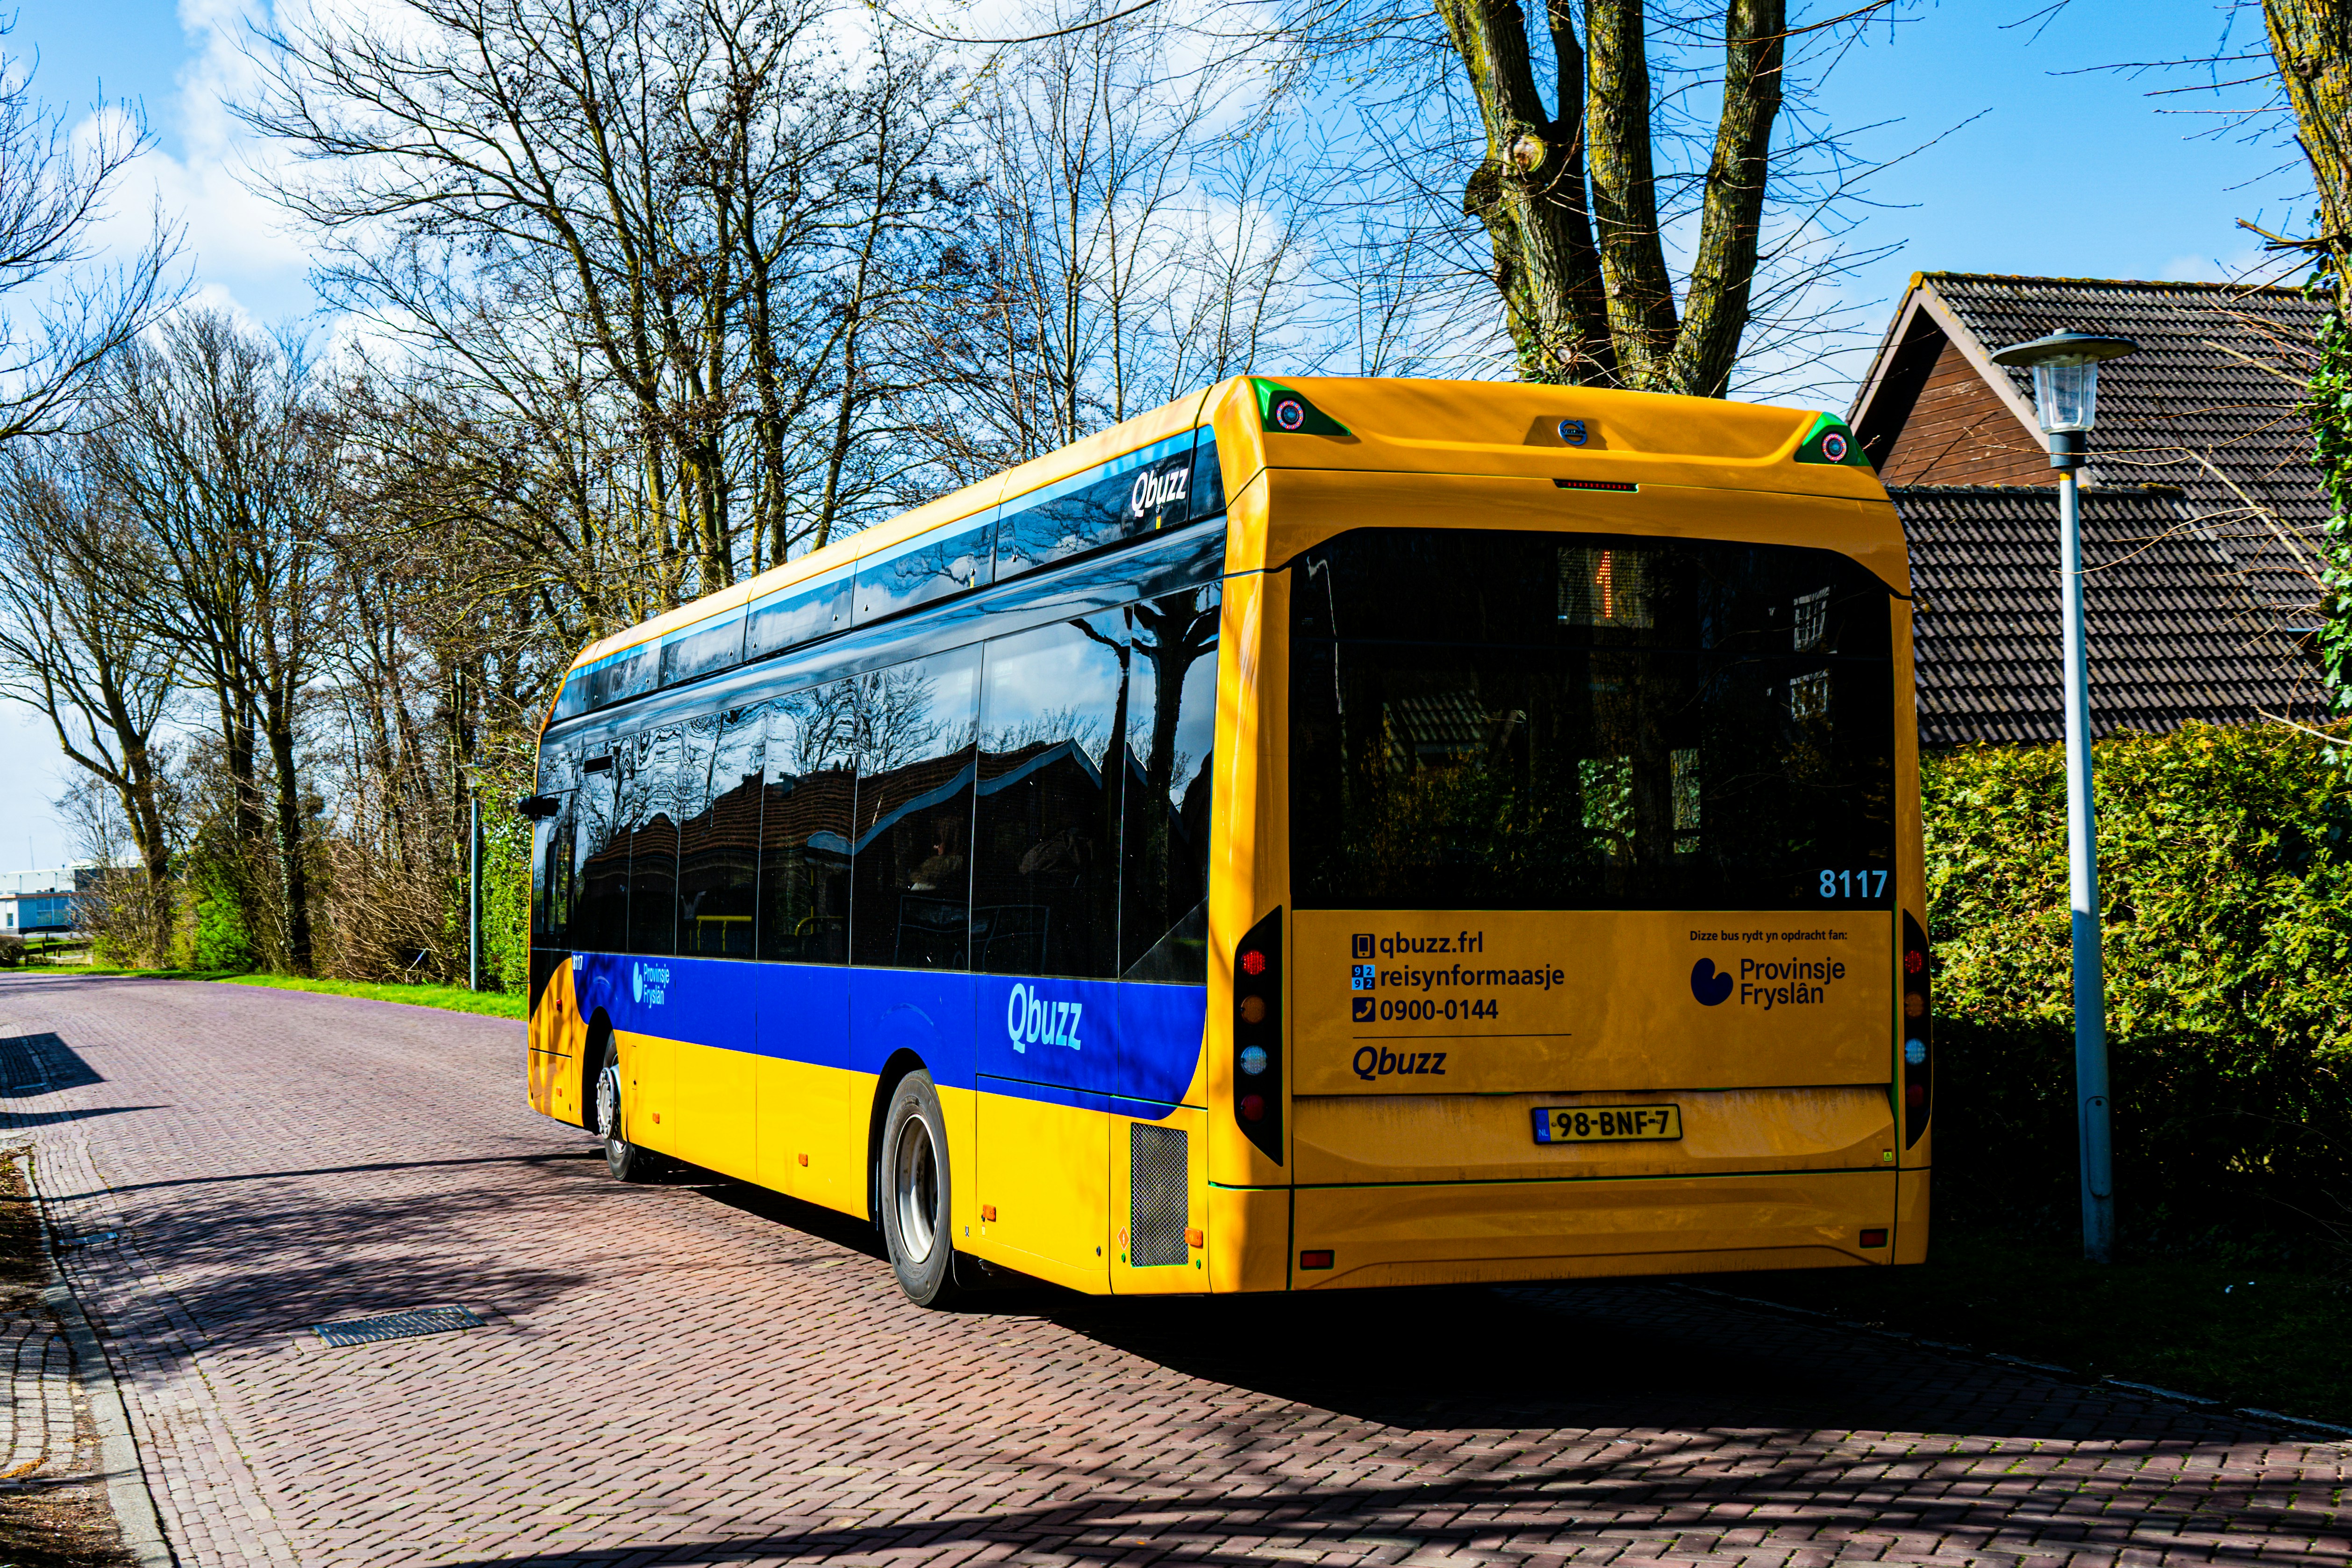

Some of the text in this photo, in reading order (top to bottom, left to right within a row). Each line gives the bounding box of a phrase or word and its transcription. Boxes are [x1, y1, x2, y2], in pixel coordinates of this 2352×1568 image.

[1131, 468, 1188, 518] Qbuzz
[1596, 551, 1612, 618] 1
[1820, 869, 1887, 898] 8117
[1380, 931, 1483, 959] qbuzz.frl
[1690, 930, 1848, 943] Dizze bus rydt yn opdracht fan:
[572, 955, 583, 970] 8117
[643, 963, 670, 988] Provinsje
[1740, 957, 1845, 985] Provinsje
[1380, 964, 1565, 991] reisynformaasje
[643, 984, 664, 1009] Fryslân
[1380, 999, 1499, 1020] 0900-0144
[1740, 982, 1823, 1010] Fryslân
[1008, 983, 1082, 1053] Qbuzz
[1352, 1046, 1447, 1081] Qbuzz
[1557, 1110, 1669, 1137] 98-BNF-7
